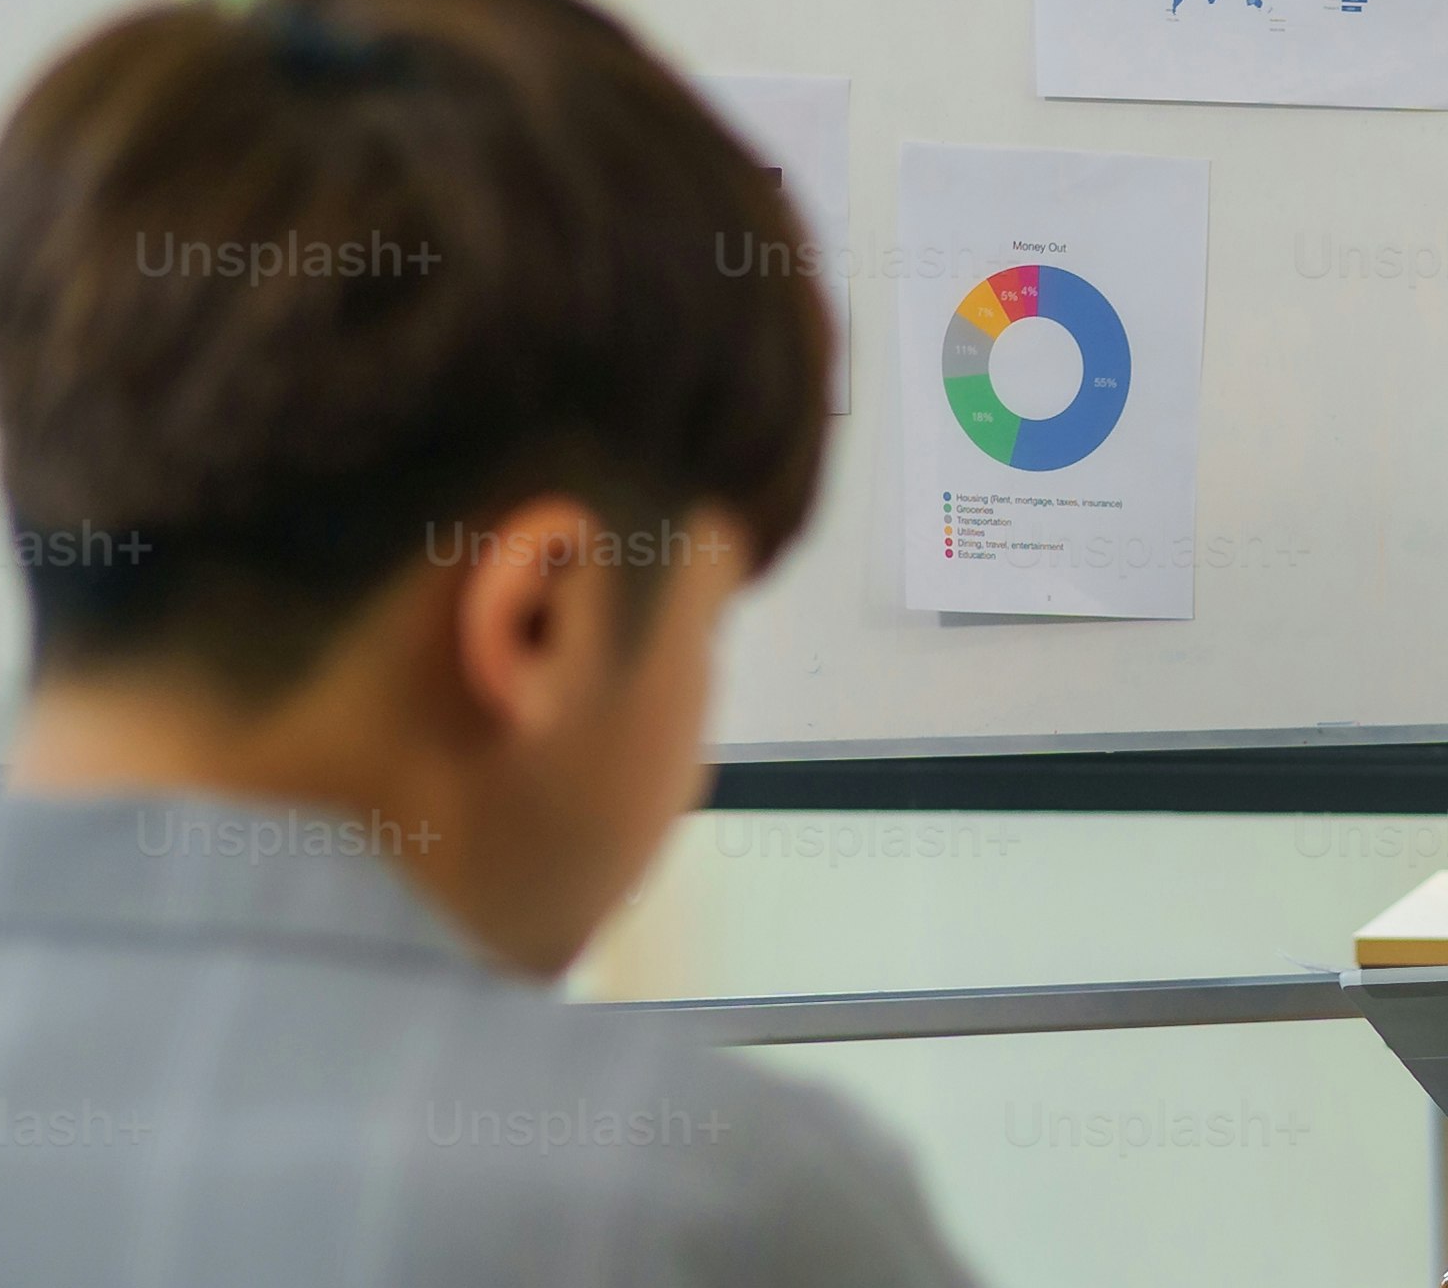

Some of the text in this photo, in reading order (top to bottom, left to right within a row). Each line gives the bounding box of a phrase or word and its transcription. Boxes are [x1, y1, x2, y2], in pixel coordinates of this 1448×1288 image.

[1012, 241, 1067, 253] Money Out
[1000, 290, 1018, 302] 5%
[1021, 286, 1038, 297] 4%
[978, 307, 994, 317] 7%
[955, 345, 978, 355] 11%
[1094, 377, 1117, 389] 55%
[972, 411, 993, 423] 18%
[956, 495, 989, 505] Housing
[1014, 498, 1054, 508] mortgage,
[956, 505, 994, 515] Groceries
[956, 517, 1012, 527] Transportation
[1011, 542, 1064, 551] entertainment
[958, 551, 996, 560] Education
